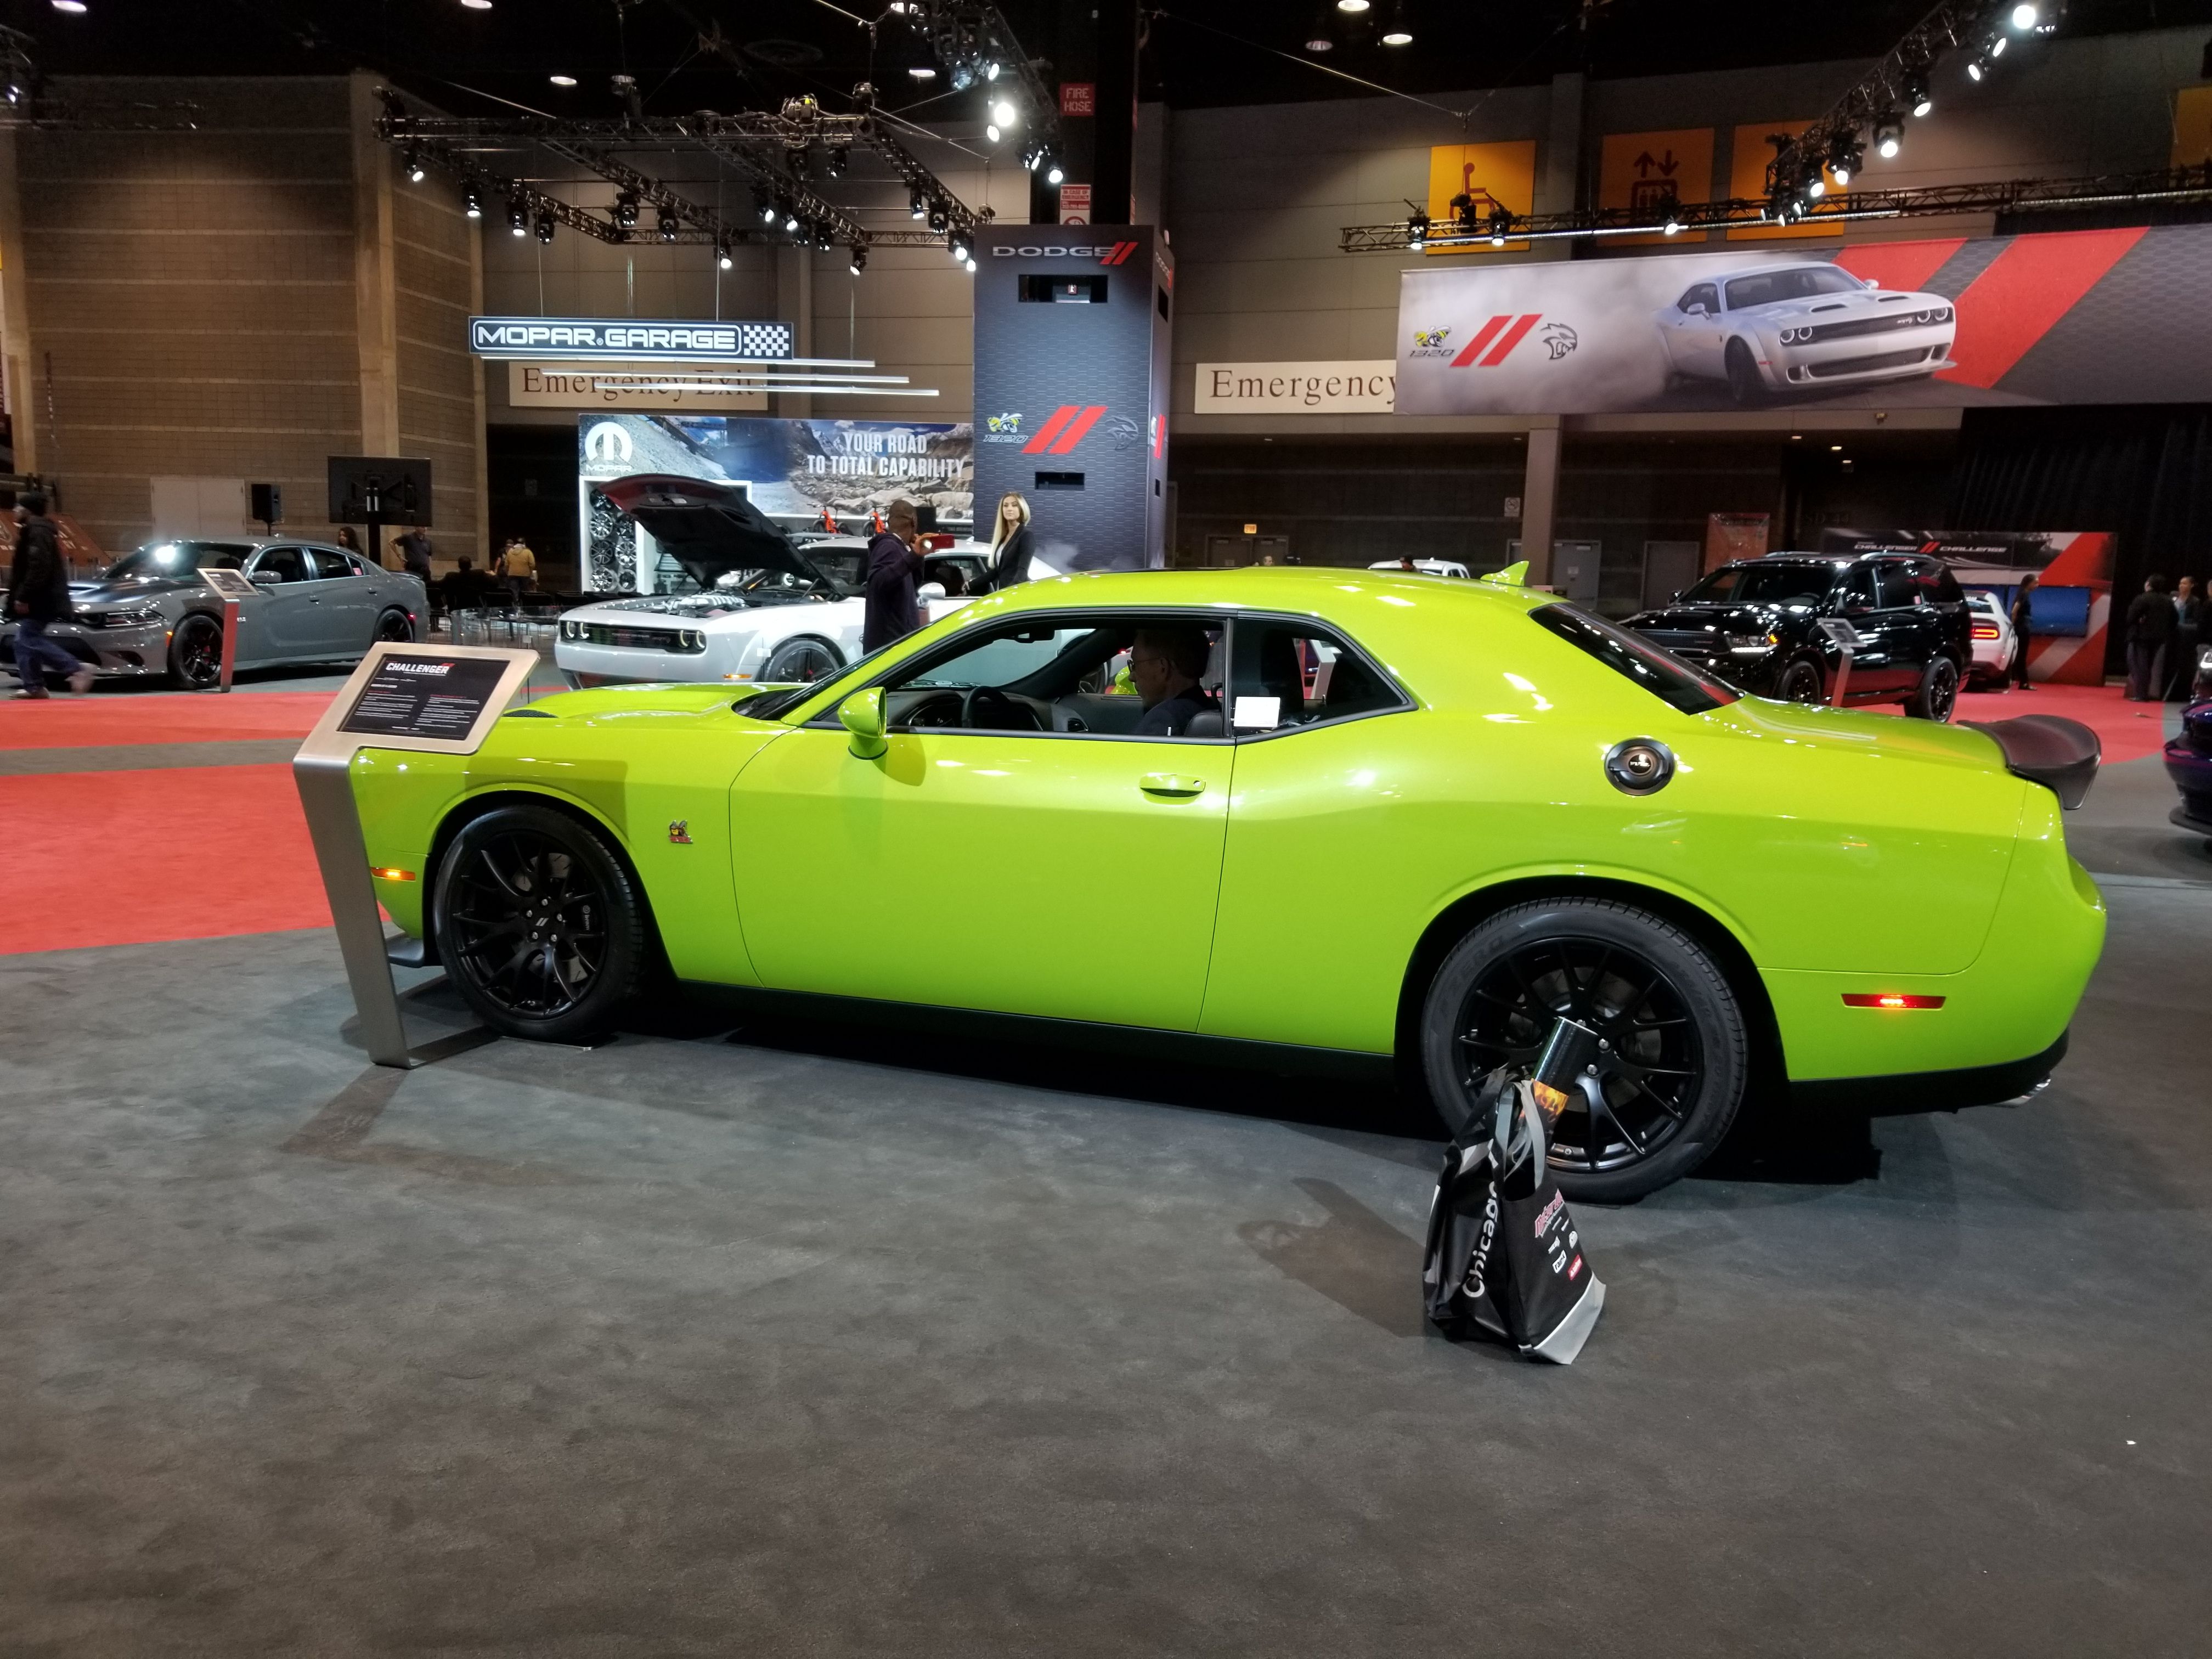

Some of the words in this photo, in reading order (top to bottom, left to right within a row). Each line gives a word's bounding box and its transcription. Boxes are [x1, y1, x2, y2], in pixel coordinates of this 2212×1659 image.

[1066, 88, 1089, 99] FIRE
[1064, 101, 1091, 112] HOSE
[992, 246, 1116, 257] DODGE
[478, 326, 596, 346] MOPAR
[605, 328, 735, 349] GARAGE
[1409, 349, 1454, 357] 1320
[842, 432, 883, 453] YOUR
[887, 434, 927, 454] ROAD
[983, 435, 1029, 443] 1320
[586, 464, 632, 472] MOPAR
[808, 455, 826, 475] TO
[830, 455, 874, 476] TOTAL
[879, 457, 966, 478] CAPABILITY
[385, 663, 449, 674] CHALLENGER
